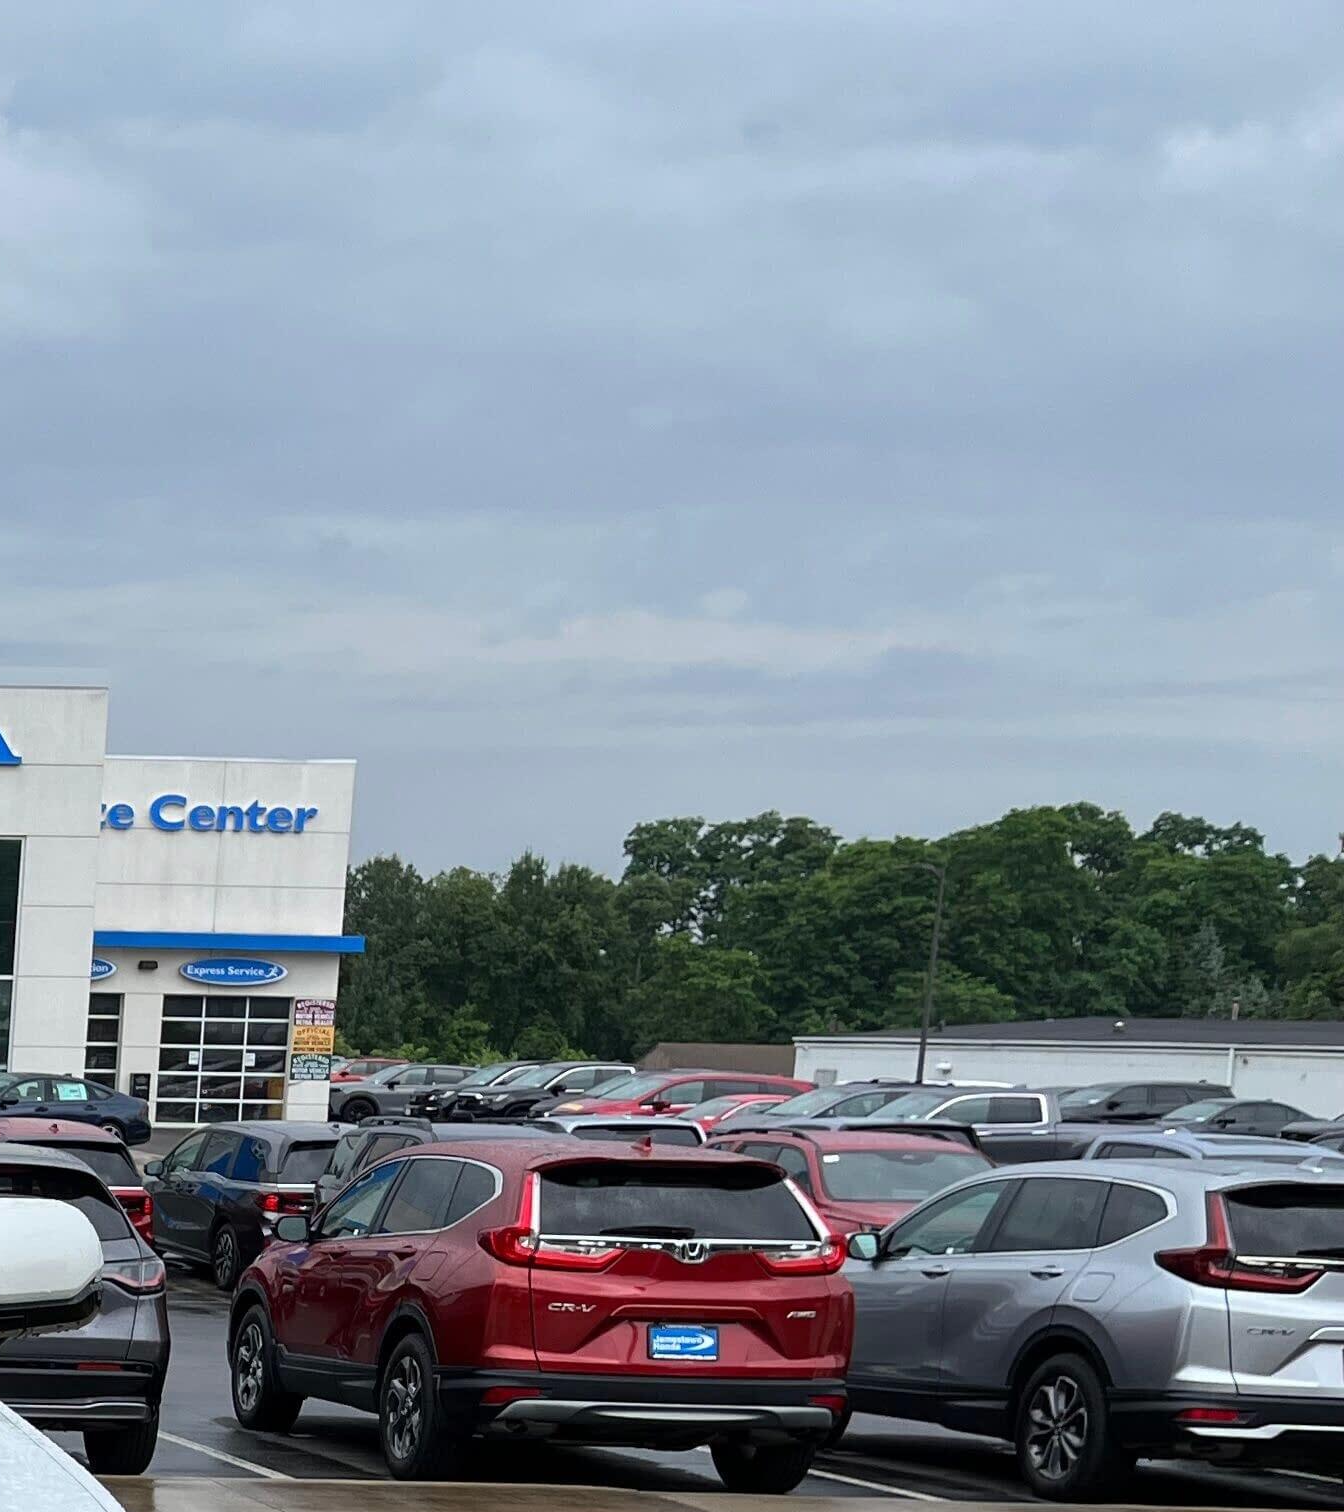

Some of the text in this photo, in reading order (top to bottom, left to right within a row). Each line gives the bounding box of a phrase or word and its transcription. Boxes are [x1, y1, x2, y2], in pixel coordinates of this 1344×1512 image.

[149, 794, 319, 834] Center
[186, 964, 265, 978] Express Service
[547, 1302, 597, 1312] CR-V
